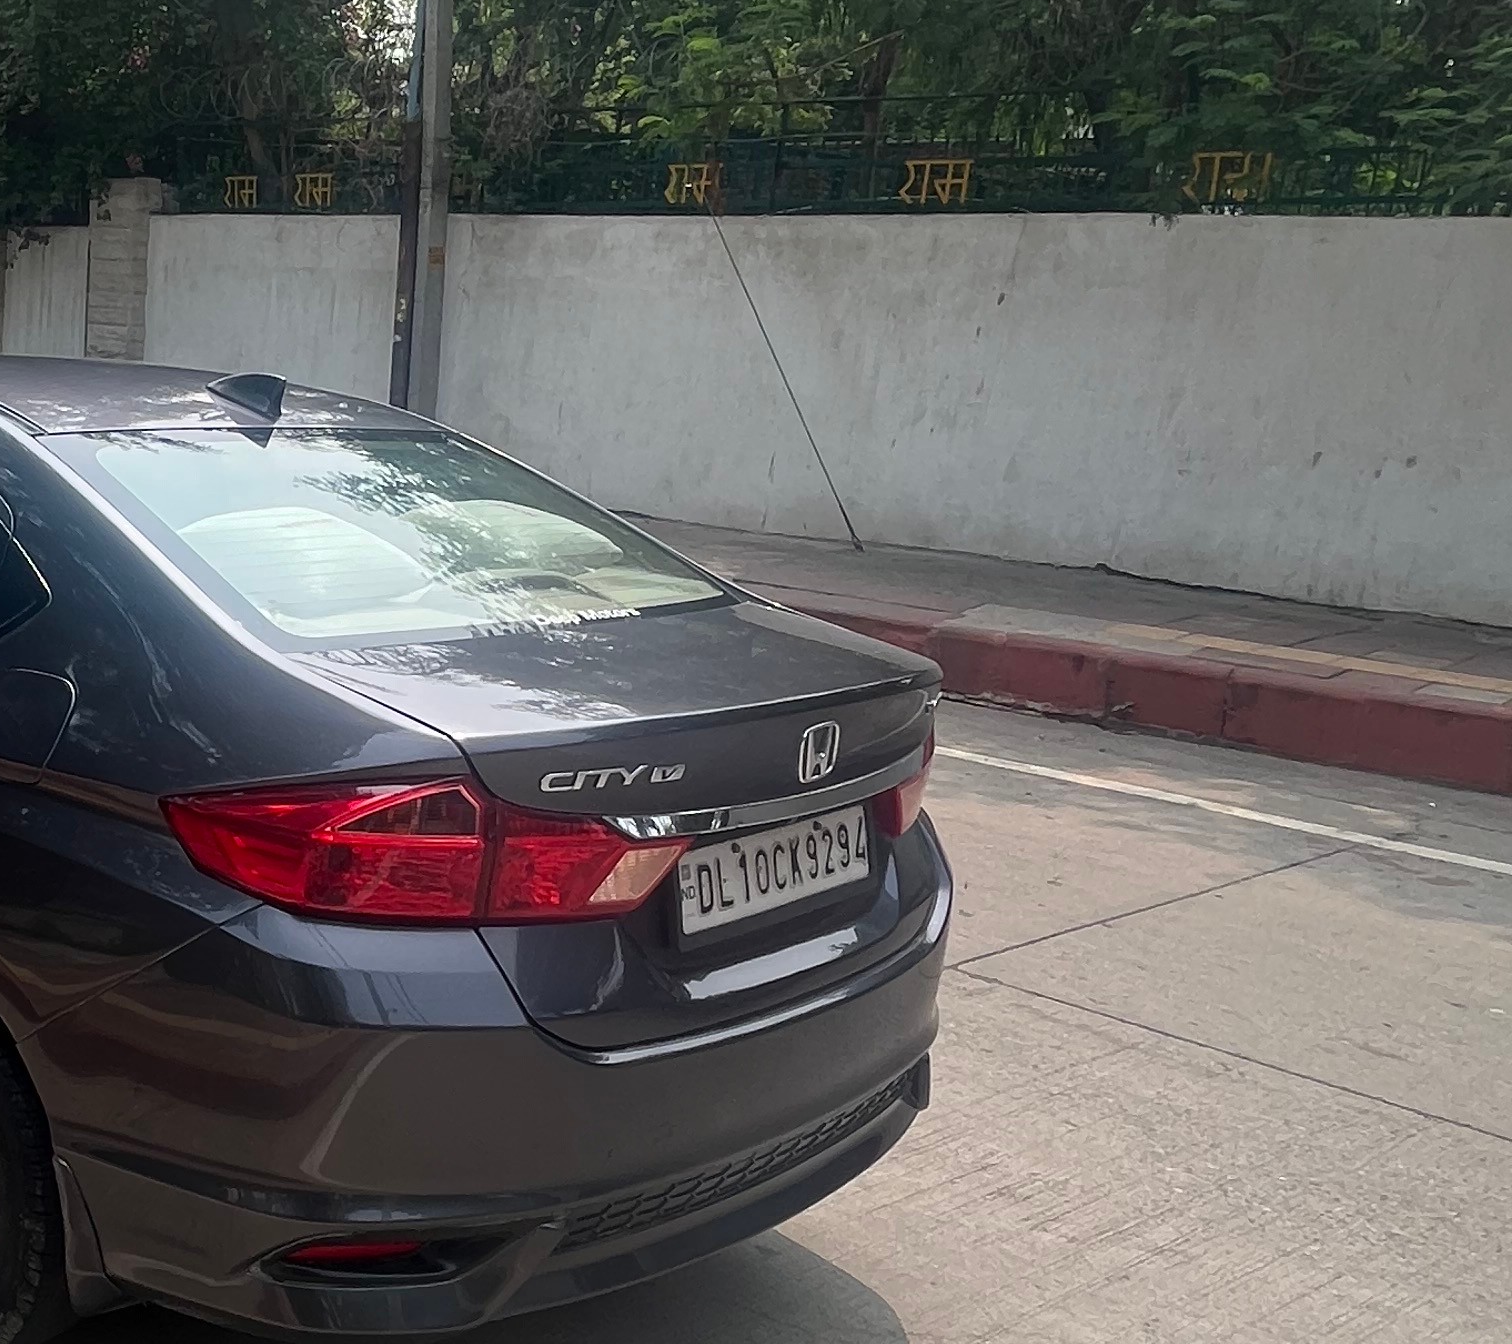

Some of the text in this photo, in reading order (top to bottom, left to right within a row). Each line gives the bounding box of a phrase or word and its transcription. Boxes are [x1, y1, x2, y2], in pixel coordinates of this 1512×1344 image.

[224, 176, 258, 208] राम
[294, 173, 334, 207] राम
[897, 159, 975, 205] राम
[540, 764, 649, 793] CITY
[697, 815, 867, 915] DL10CK9294
